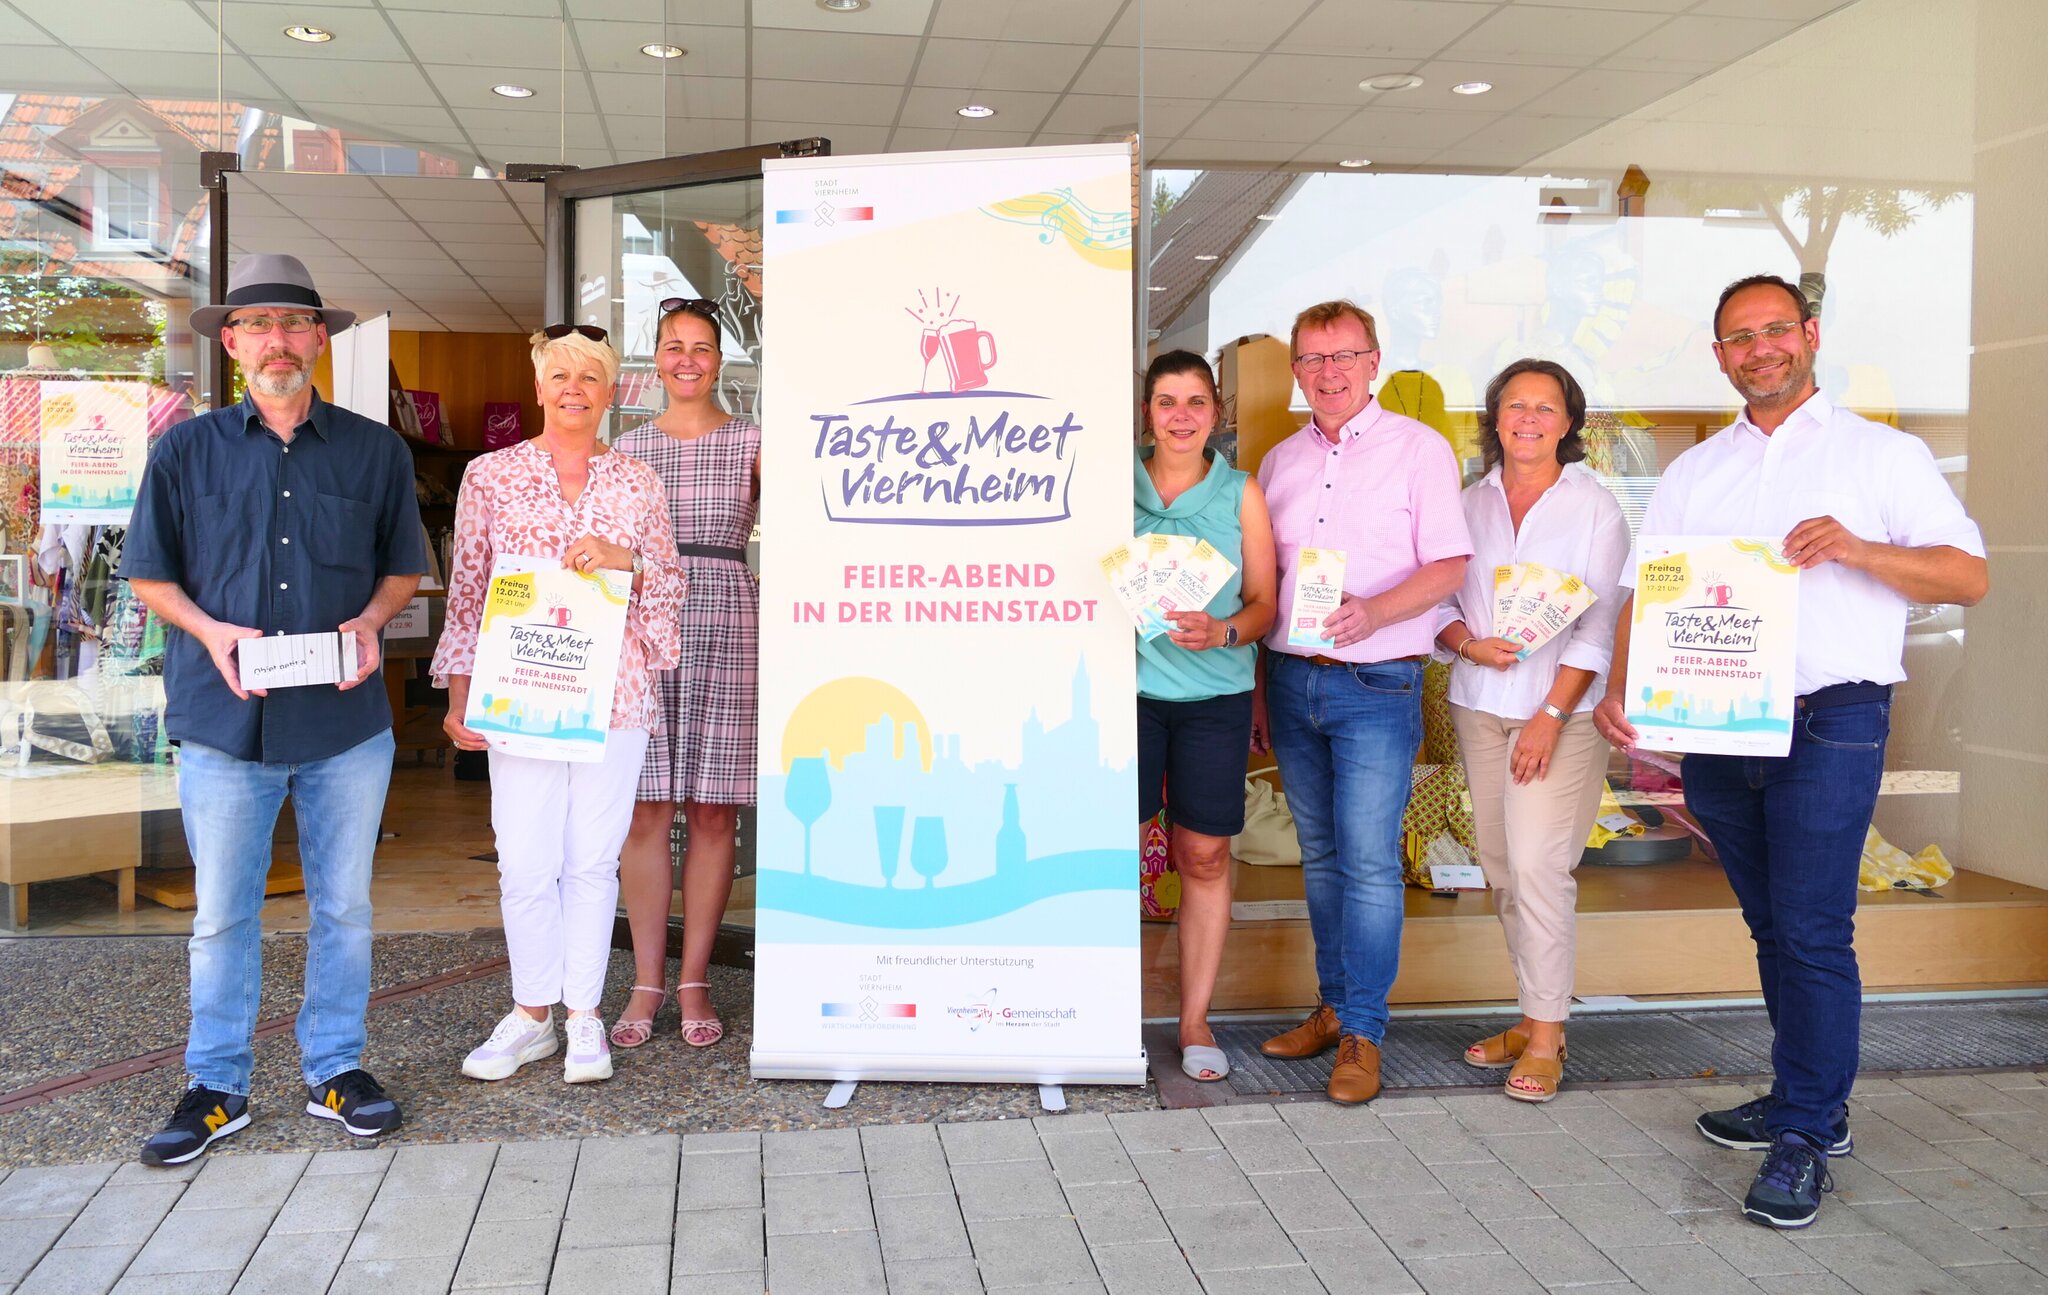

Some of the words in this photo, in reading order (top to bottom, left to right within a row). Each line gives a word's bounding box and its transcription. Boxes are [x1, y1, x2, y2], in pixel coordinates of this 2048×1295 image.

[815, 179, 838, 187] STADT
[815, 188, 859, 197] VIERNHEIM
[69, 444, 120, 454] Viernheim
[841, 462, 1056, 507] Viernheim
[1648, 564, 1682, 574] Freitag
[843, 563, 1056, 589] FEIER-ABEND
[1645, 574, 1684, 583] 12.07.24
[499, 578, 529, 591] Freitag
[495, 587, 531, 599] 12.07.24
[793, 601, 825, 623] IN
[837, 600, 893, 624] DER
[905, 599, 1099, 623] INNENSTADT
[1673, 629, 1752, 647] Viernheim
[516, 642, 583, 665] Viernheim
[1674, 655, 1748, 668] FEIER-ABEND
[514, 667, 577, 683] FEIER-ABEND
[1656, 666, 1668, 675] IN
[1671, 667, 1691, 676] DER
[1694, 668, 1763, 680] INNENSTADT
[498, 675, 509, 684] IN
[511, 677, 529, 687] DER
[531, 680, 588, 695] INNENSTADT
[876, 955, 893, 965] Mit
[895, 955, 957, 966] freundlicher
[960, 956, 1034, 969] Unterstützung
[859, 974, 882, 982] STADT
[859, 984, 902, 992] VIERNHEIM
[947, 1006, 978, 1015] Viernheim
[1002, 1007, 1077, 1020] Gemeinschaft
